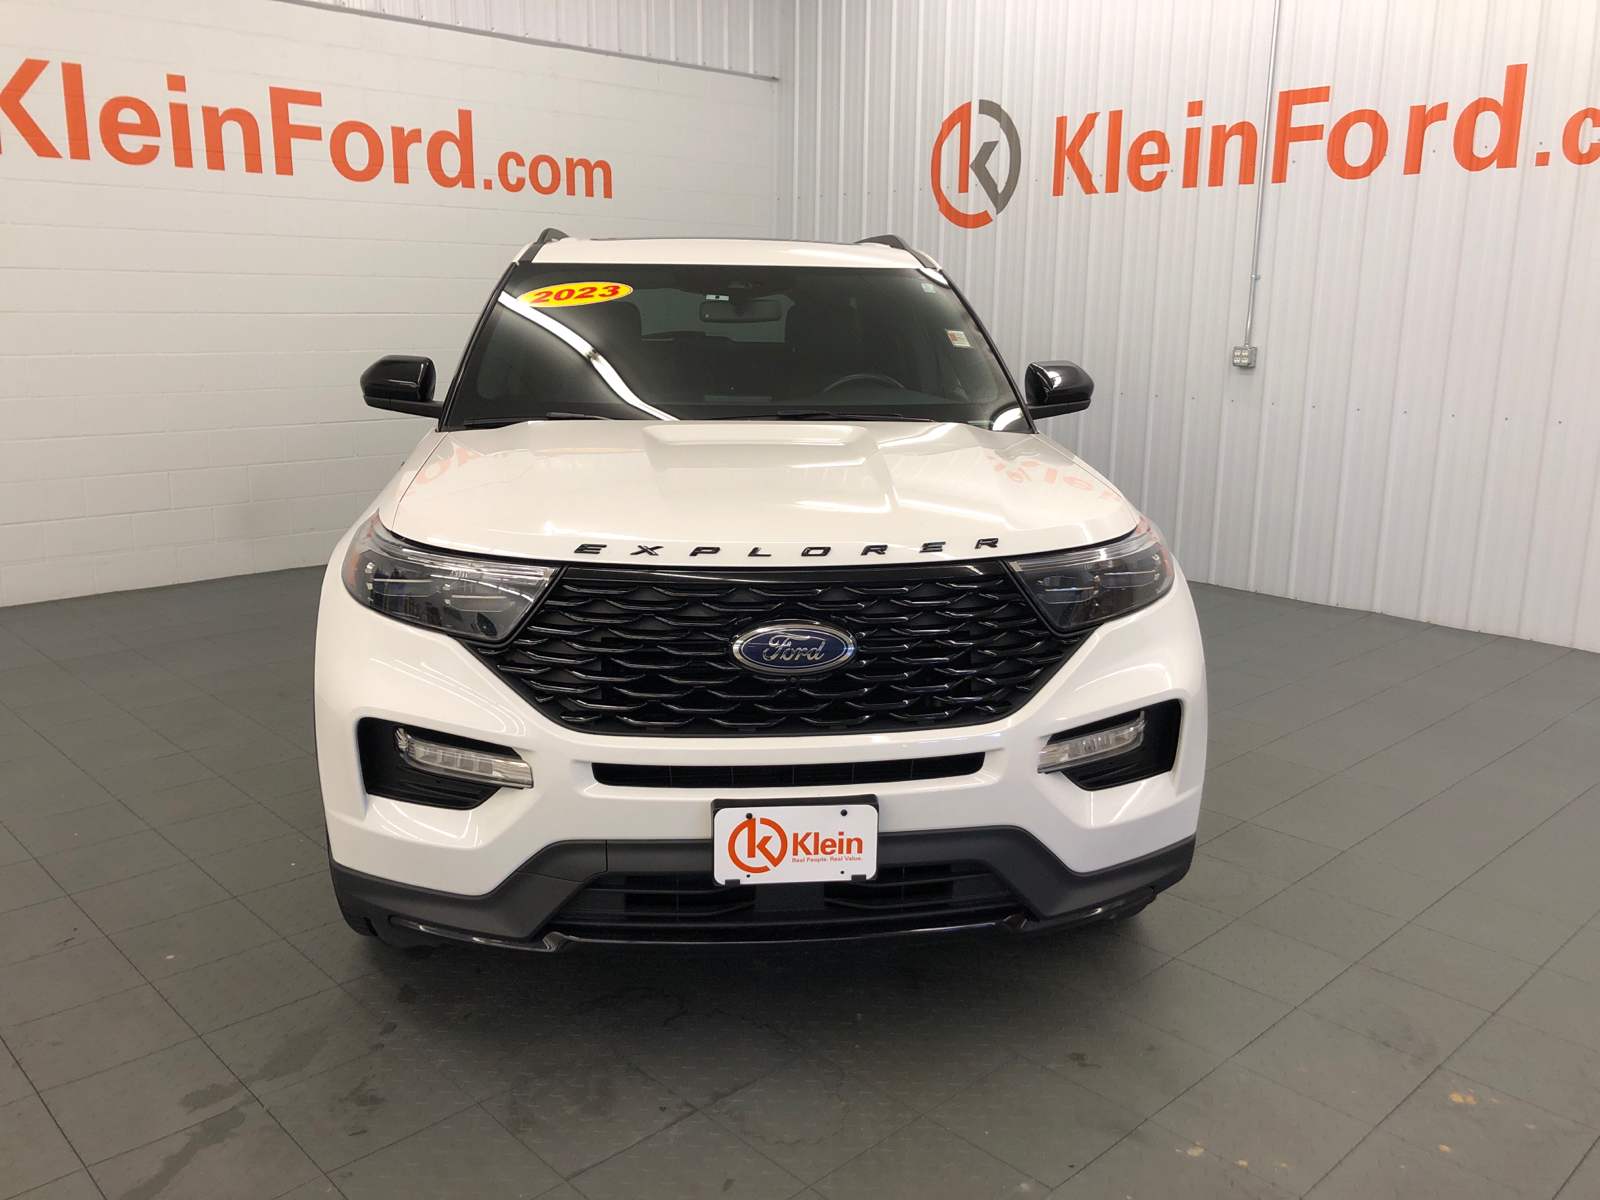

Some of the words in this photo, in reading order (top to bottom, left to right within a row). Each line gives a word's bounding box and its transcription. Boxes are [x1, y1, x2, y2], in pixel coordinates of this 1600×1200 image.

[529, 285, 621, 305] 2023
[573, 537, 999, 557] EXPLORER
[762, 633, 826, 661] Ford
[792, 831, 864, 857] Klein
